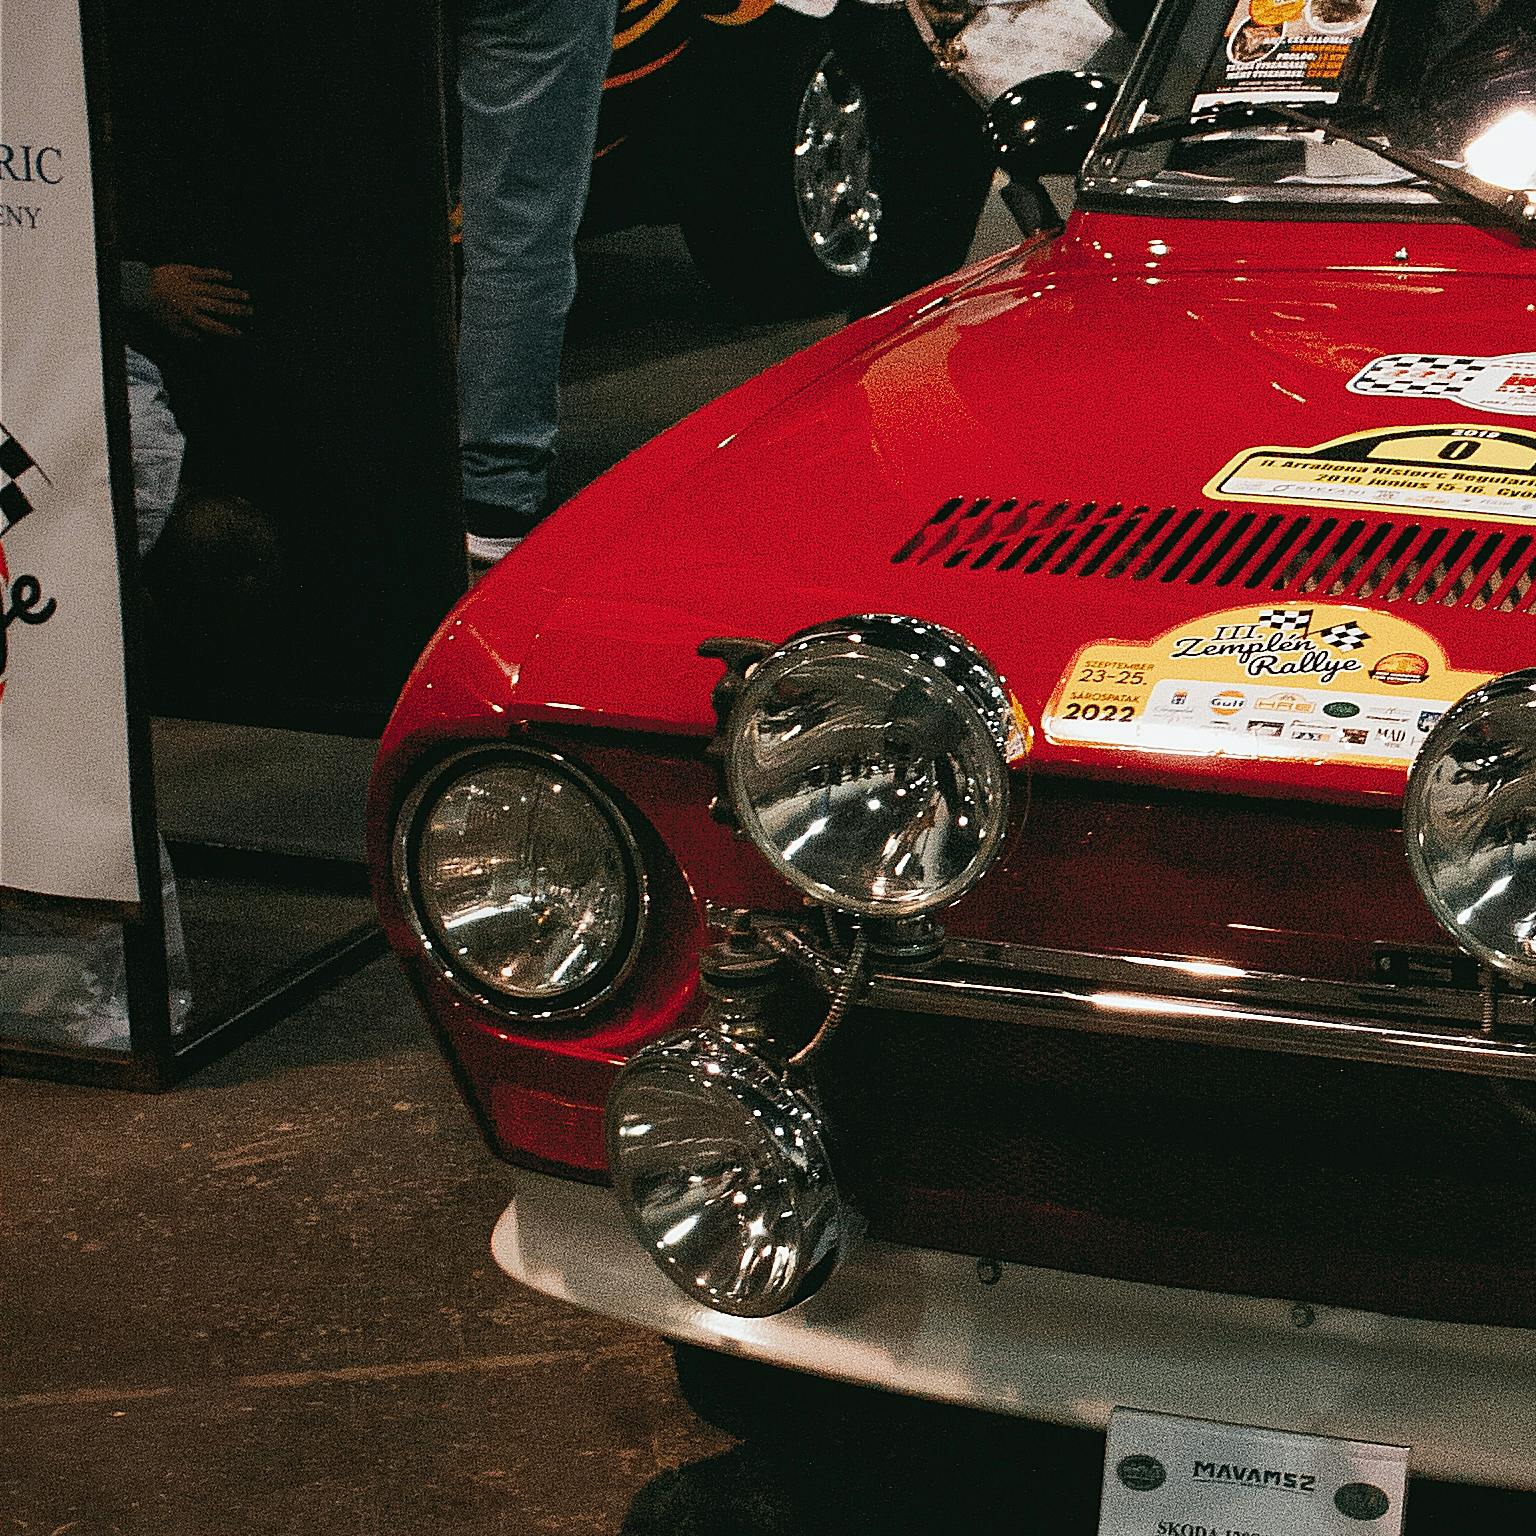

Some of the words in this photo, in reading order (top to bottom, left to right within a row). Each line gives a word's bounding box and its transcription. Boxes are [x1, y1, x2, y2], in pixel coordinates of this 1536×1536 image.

[1451, 429, 1500, 439] 2019
[1438, 440, 1481, 461] 0
[1281, 460, 1369, 474] Arrabona
[1373, 466, 1449, 481] Historic
[1212, 624, 1264, 642] III.
[1172, 632, 1317, 663] Zemplén
[1085, 661, 1155, 671] SZEPTEMBER
[1248, 650, 1362, 684] Rallye
[1078, 668, 1148, 686] 23-25.
[1210, 697, 1246, 708] Gulf
[1062, 703, 1135, 723] 2022
